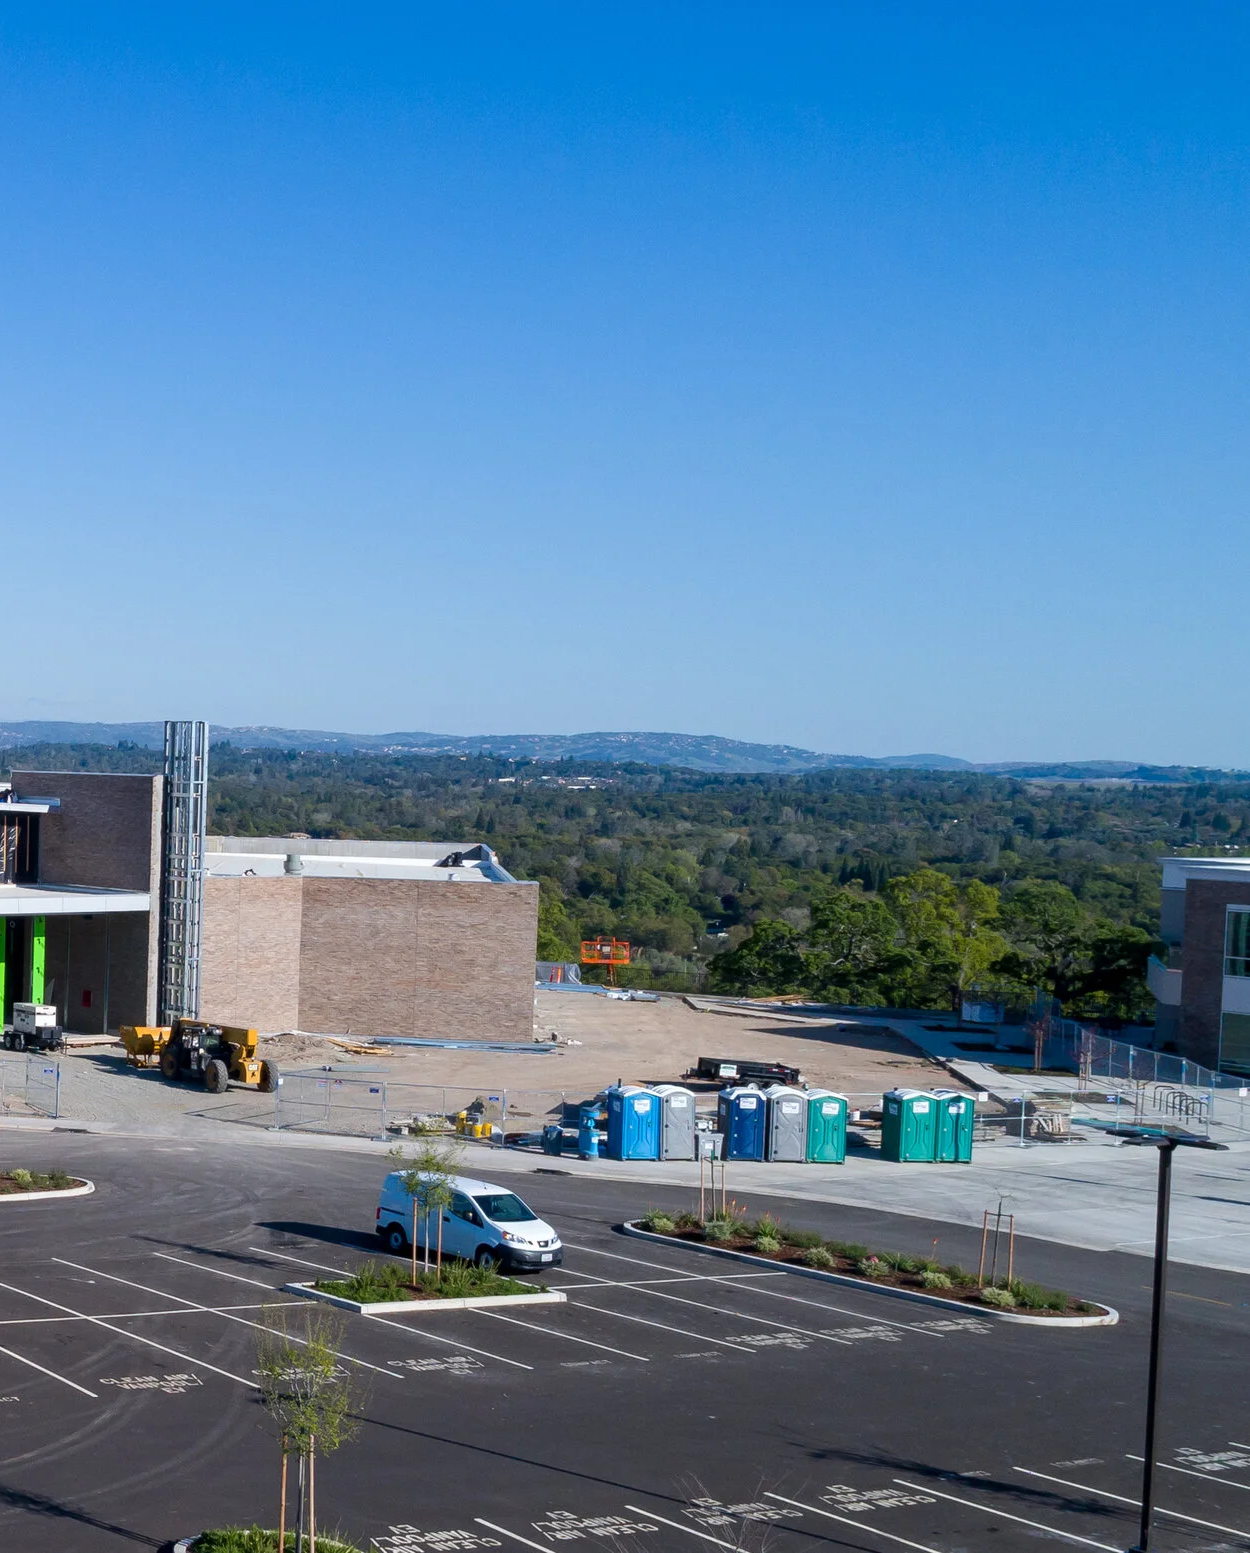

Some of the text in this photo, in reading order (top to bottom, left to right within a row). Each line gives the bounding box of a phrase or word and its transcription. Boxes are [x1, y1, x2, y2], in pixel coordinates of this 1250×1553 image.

[99, 1376, 159, 1384] CLEAN
[388, 1524, 421, 1534] EV
[587, 1523, 659, 1536] CLEAN
[370, 1529, 478, 1548] VANPOOL/
[426, 1538, 502, 1552] CLEAN
